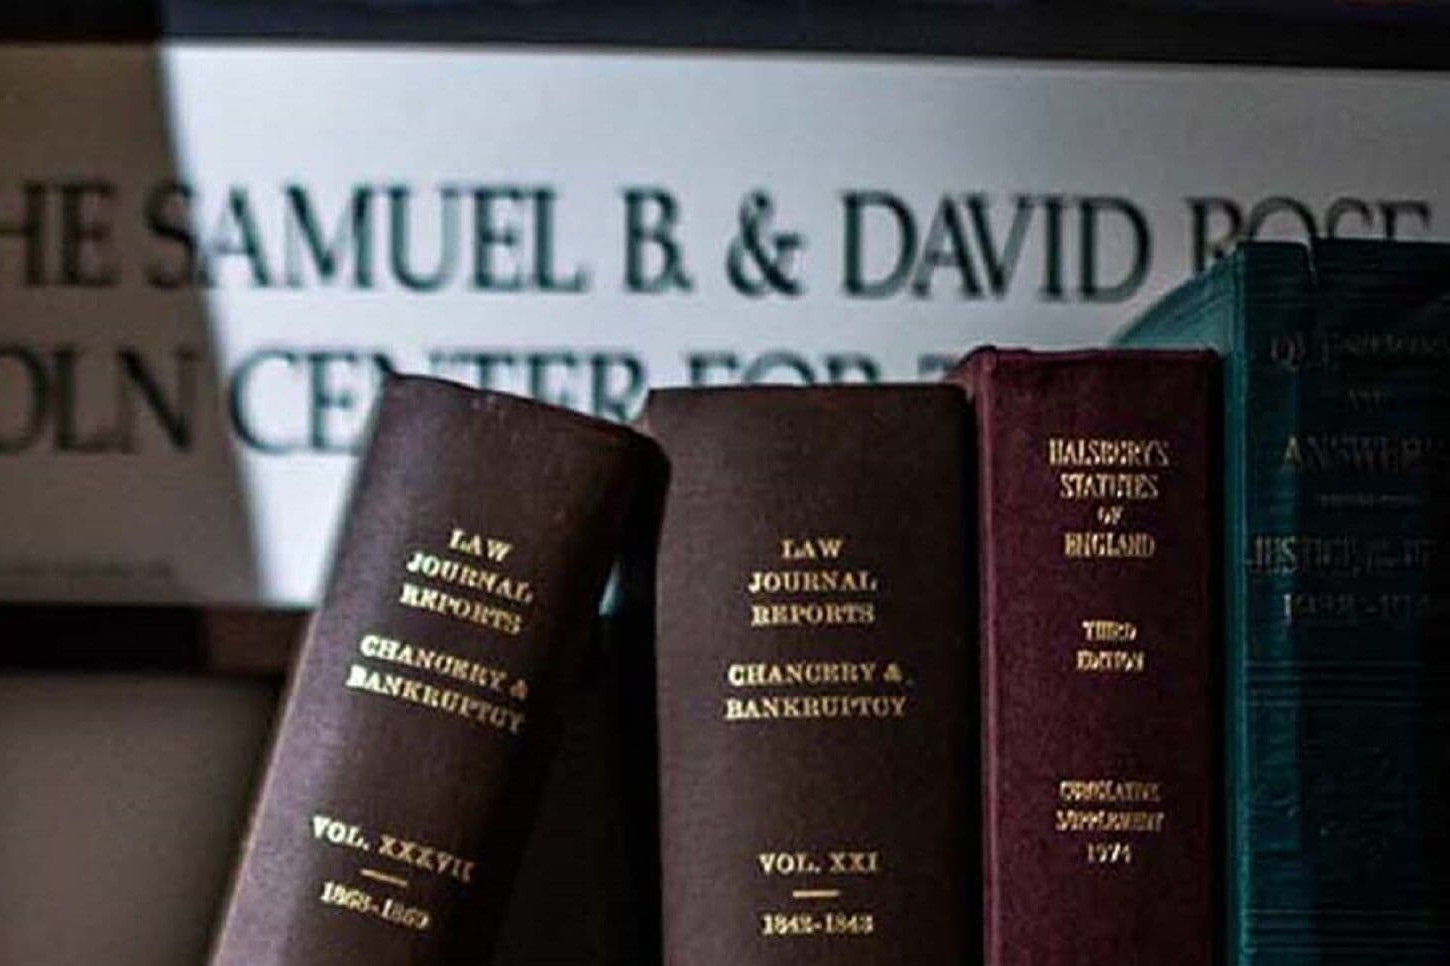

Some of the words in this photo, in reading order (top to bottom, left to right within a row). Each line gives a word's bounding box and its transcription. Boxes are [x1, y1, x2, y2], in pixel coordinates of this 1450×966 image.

[144, 180, 585, 294] SAMUEL
[726, 188, 803, 297] &
[840, 190, 1151, 300] DAVID
[230, 350, 648, 453] CETER
[449, 529, 514, 563] LAW
[782, 539, 844, 559] LAW
[1064, 532, 1155, 557] ENGLAND
[407, 552, 534, 604] JOURNAL
[749, 570, 878, 593] JOURNAL
[400, 584, 522, 636] REPORTS
[751, 603, 876, 627] REPORTS
[361, 634, 507, 693] CHANCERY
[729, 664, 875, 688] CHANCERY
[347, 666, 527, 735] BANKRUPTCY
[724, 696, 907, 721] BANKRUPTCY
[313, 815, 370, 851] VOL.
[759, 853, 822, 875] VOL.
[828, 852, 879, 873] XXI
